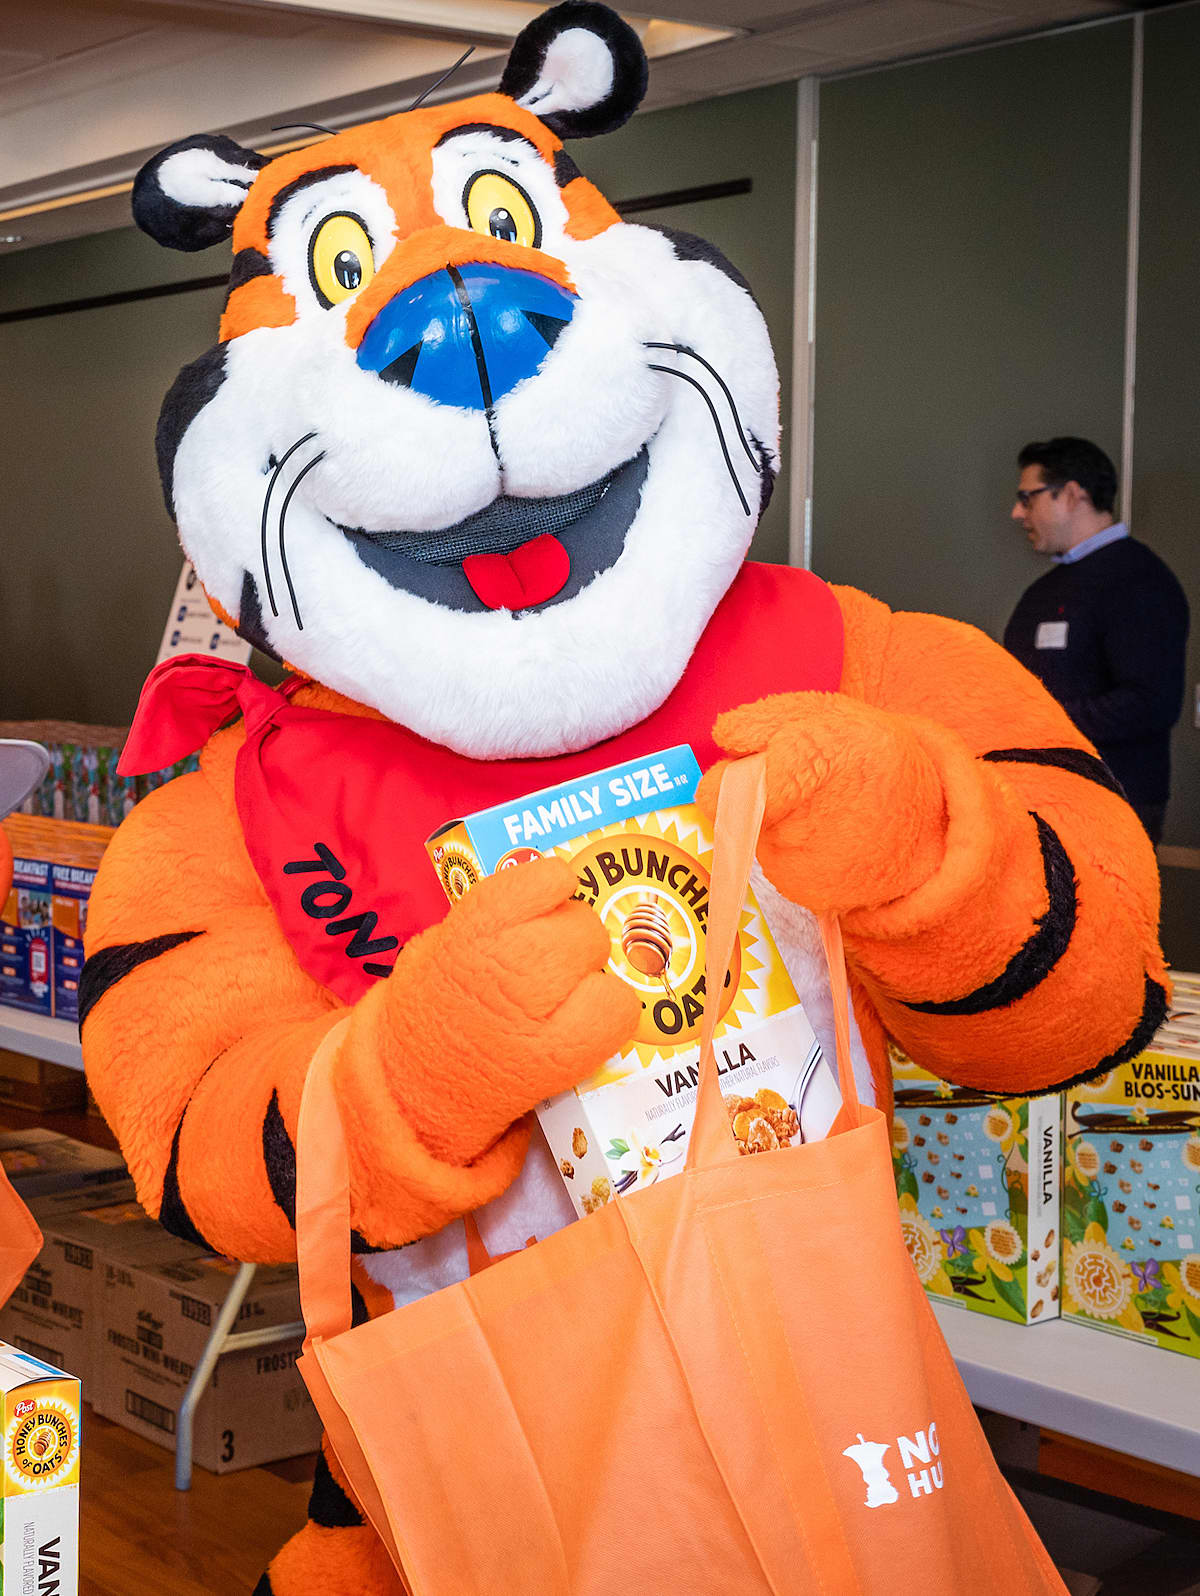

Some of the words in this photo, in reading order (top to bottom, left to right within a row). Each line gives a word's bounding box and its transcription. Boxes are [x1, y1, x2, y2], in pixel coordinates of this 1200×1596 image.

[502, 786, 602, 845] FAMILY
[608, 764, 674, 807] SIZE
[448, 856, 476, 884] BUNCHES
[283, 842, 401, 978] TON
[596, 848, 709, 935] BUNCHE
[655, 1043, 756, 1098] VANLLA
[1132, 1064, 1200, 1079] VANILLA
[1124, 1082, 1200, 1100] BLOS-SU
[1042, 1125, 1054, 1205] VANILLA
[256, 1352, 299, 1375] FROST
[15, 1401, 35, 1415] Post
[16, 1415, 36, 1455] HONEY
[38, 1415, 68, 1447] BUNCHES
[221, 1429, 234, 1463] 3
